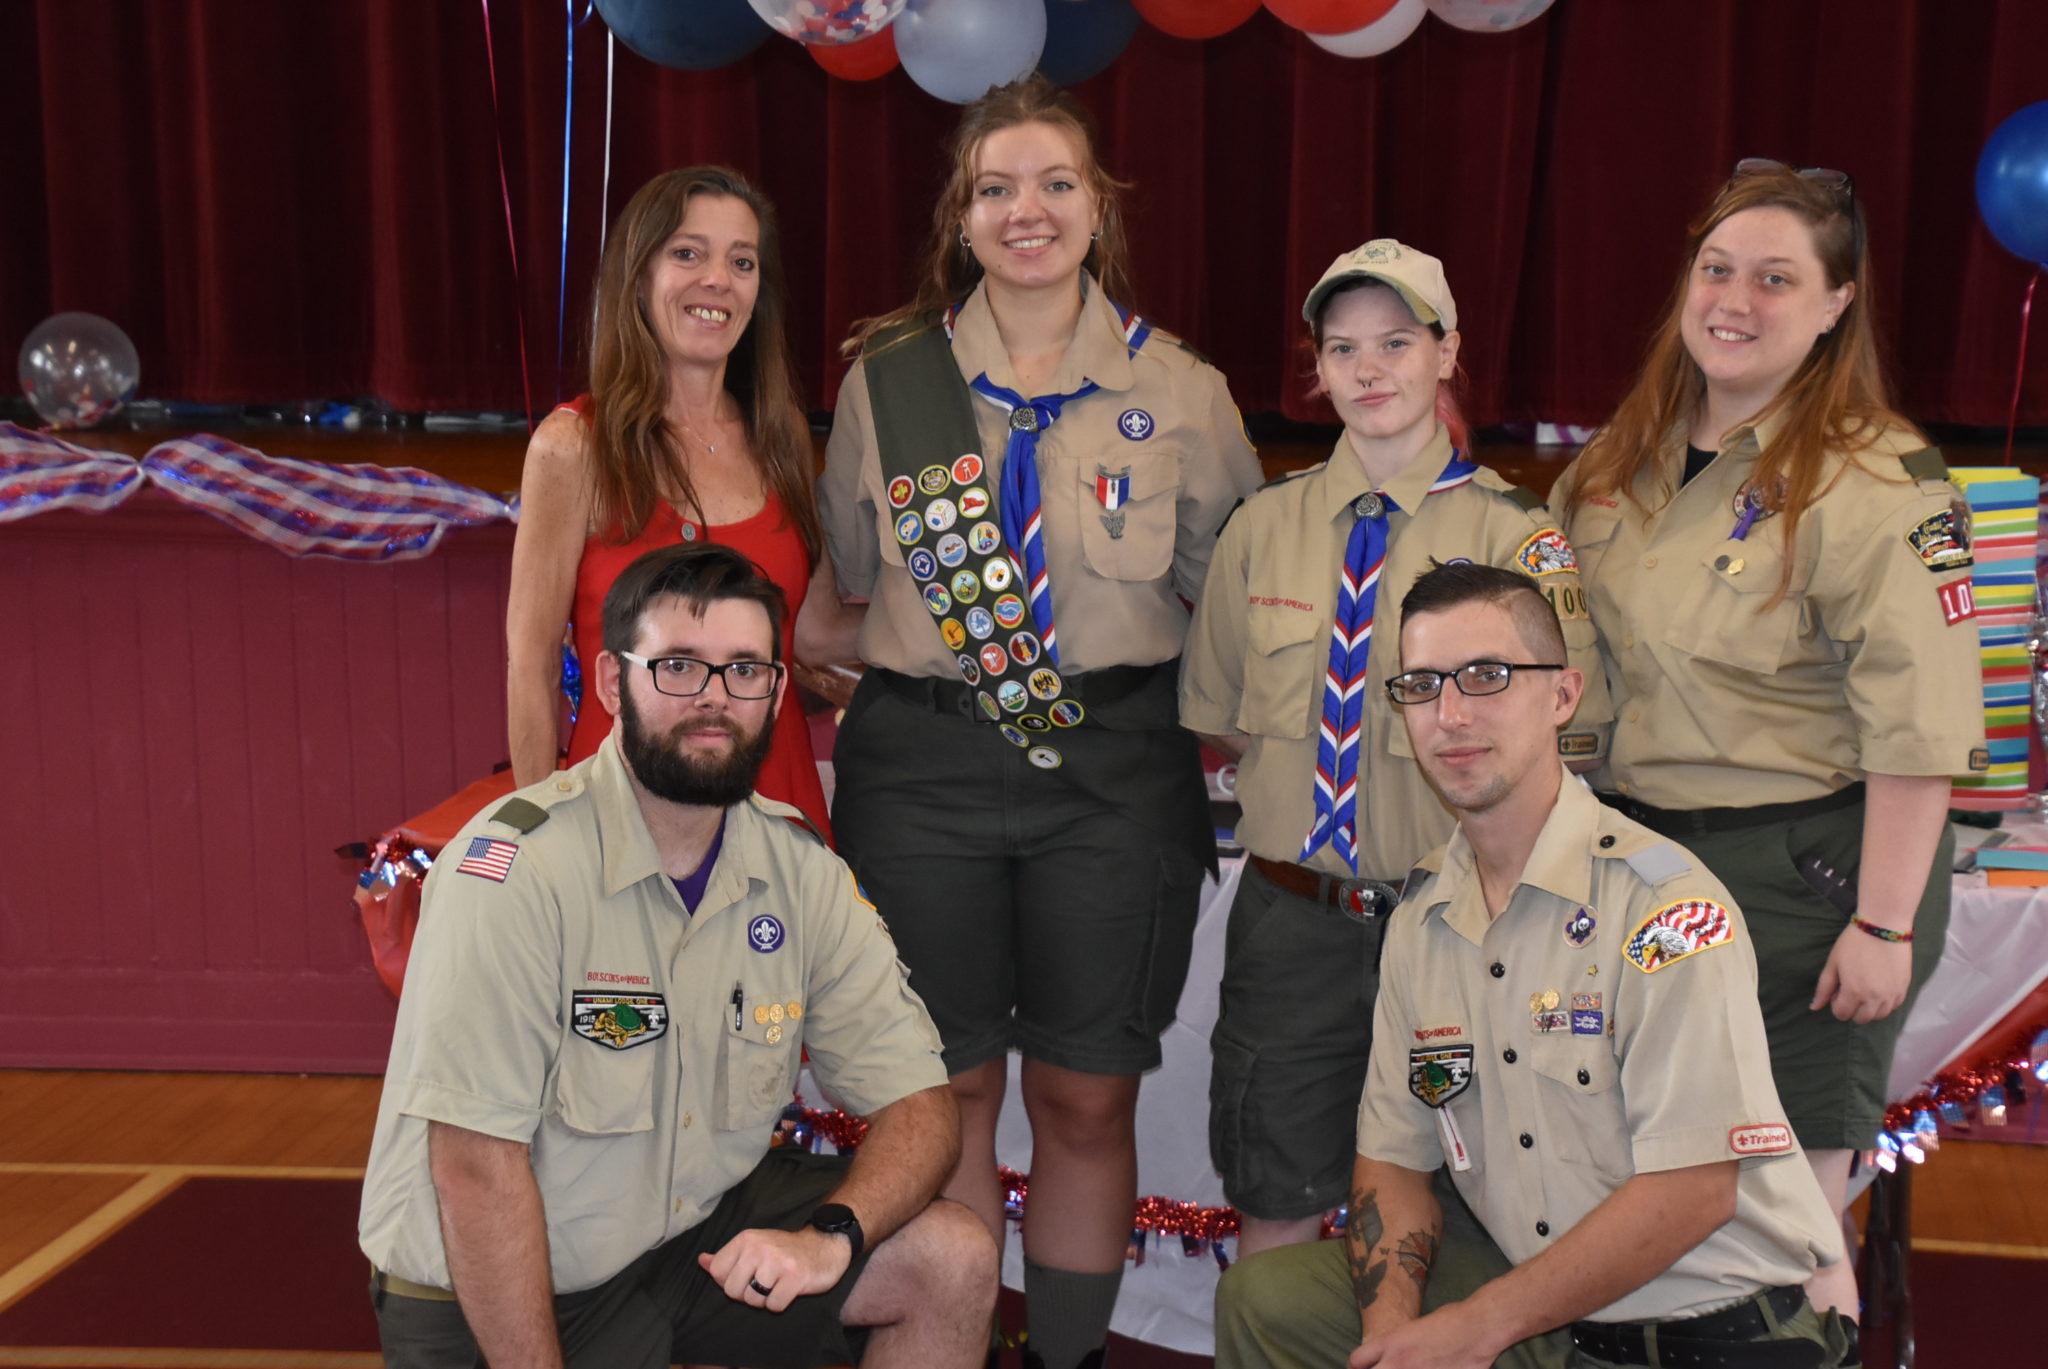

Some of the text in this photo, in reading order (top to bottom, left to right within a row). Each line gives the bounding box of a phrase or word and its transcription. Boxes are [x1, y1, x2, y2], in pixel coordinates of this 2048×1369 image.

[1284, 597, 1313, 611] AMERICA
[580, 1015, 596, 1024] 1915
[1750, 1132, 1786, 1145] Trained
